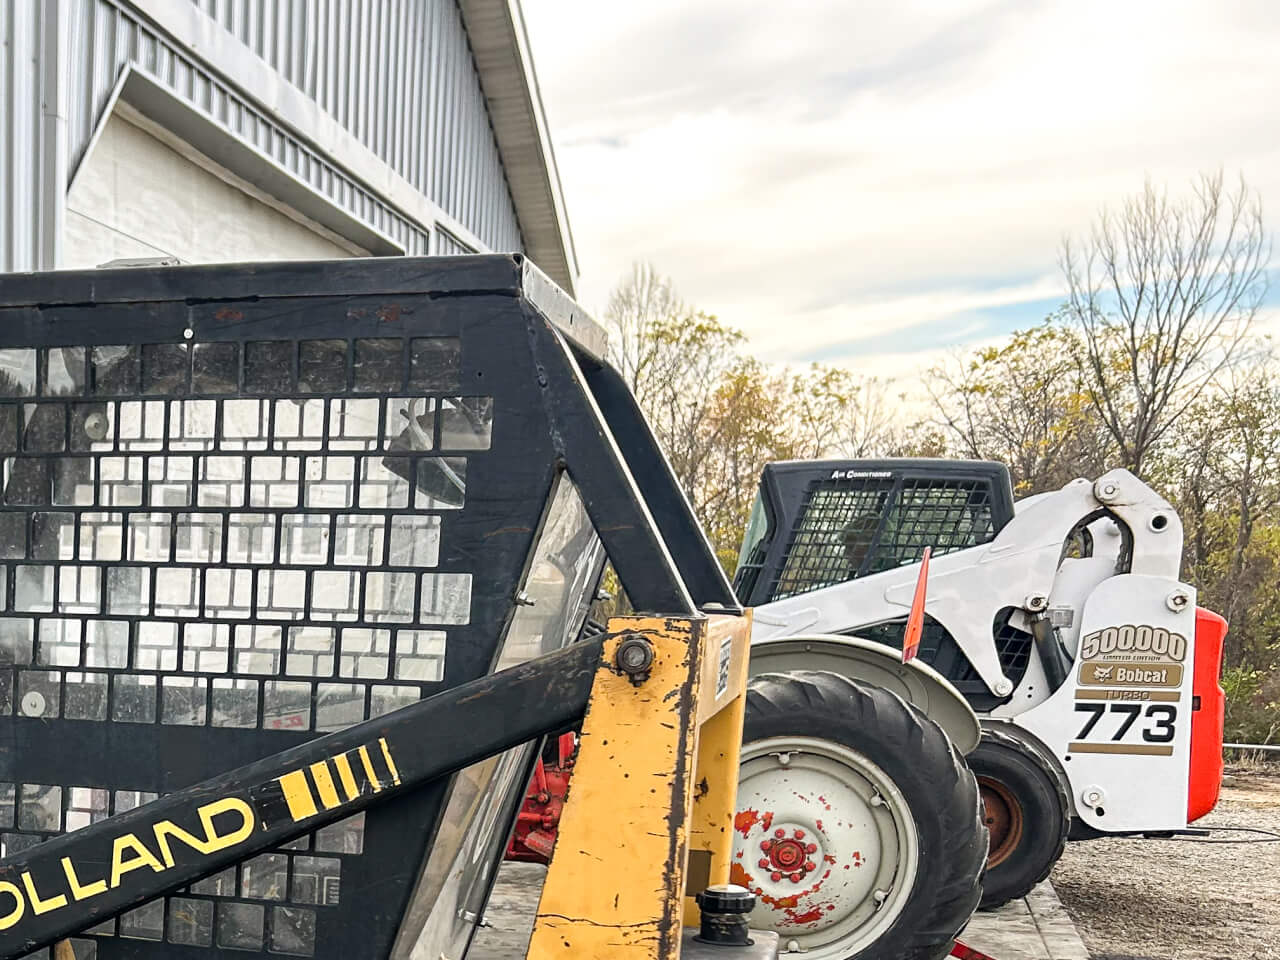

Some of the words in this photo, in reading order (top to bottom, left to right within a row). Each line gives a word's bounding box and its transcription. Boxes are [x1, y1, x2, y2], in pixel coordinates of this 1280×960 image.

[1080, 625, 1187, 661] 500,000
[1116, 667, 1168, 683] Bobcat
[1105, 690, 1151, 700] TURBO
[1074, 702, 1178, 743] 773
